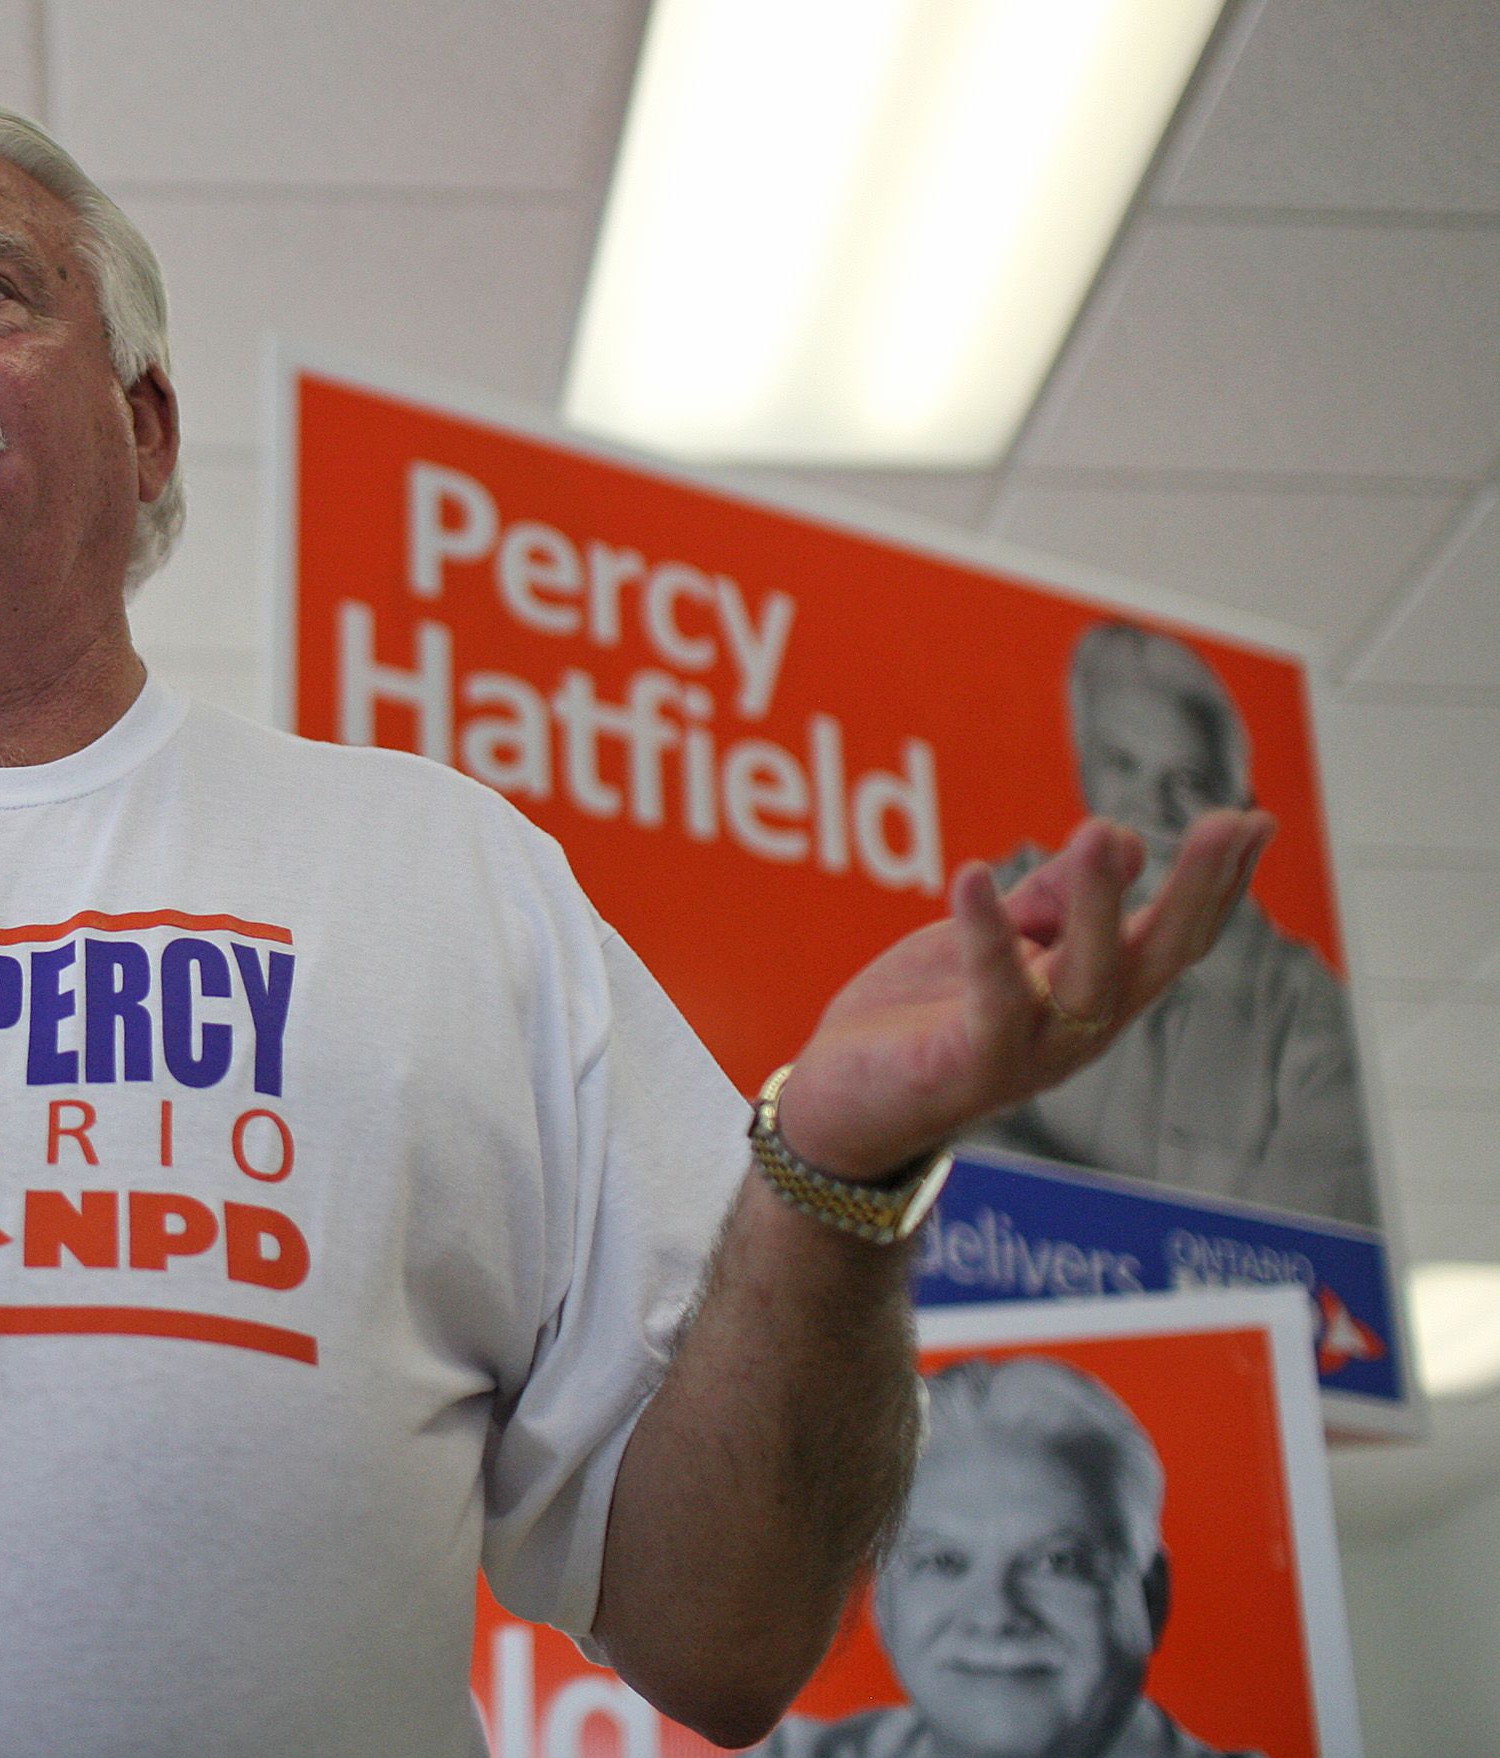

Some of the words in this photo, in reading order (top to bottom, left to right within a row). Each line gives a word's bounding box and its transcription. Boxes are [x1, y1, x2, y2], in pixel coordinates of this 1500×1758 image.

[409, 461, 796, 719] Percy
[338, 599, 944, 897] Hatfield
[23, 1189, 311, 1291] NPD
